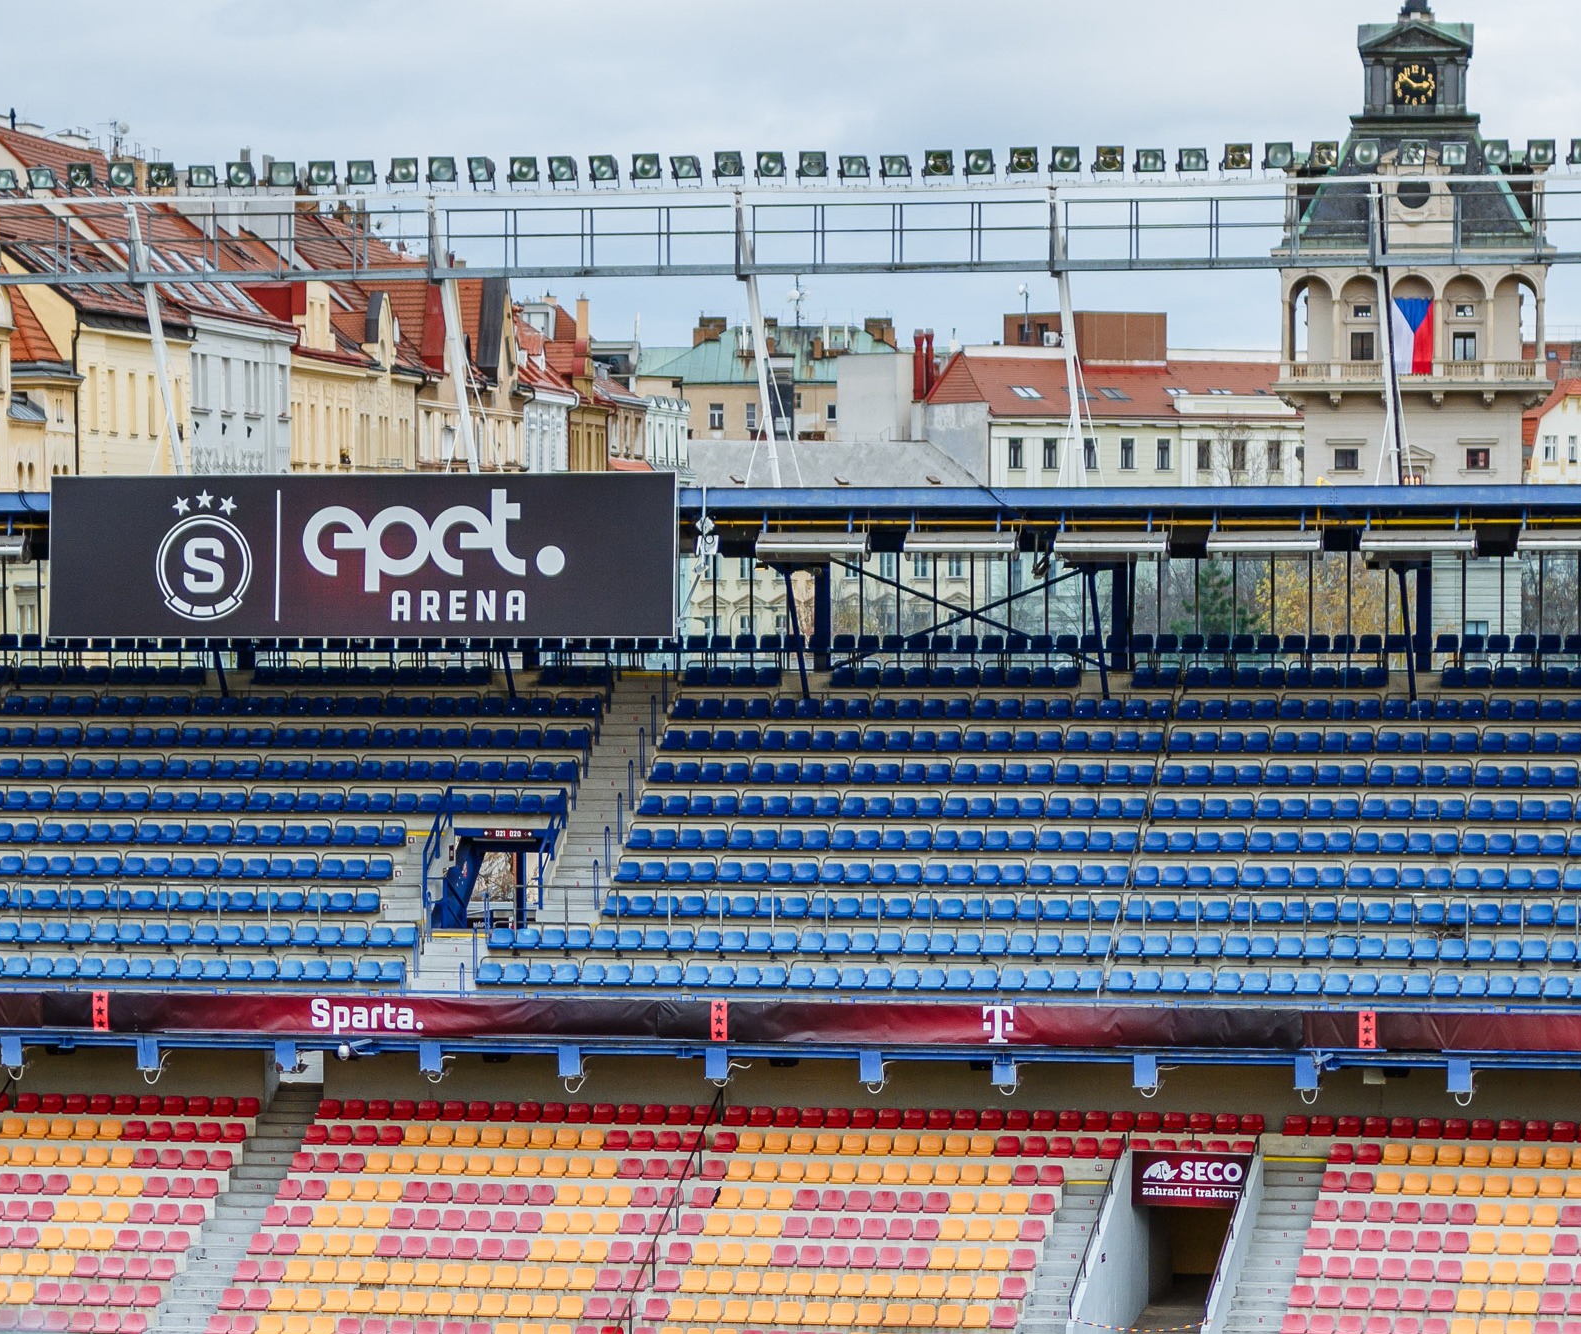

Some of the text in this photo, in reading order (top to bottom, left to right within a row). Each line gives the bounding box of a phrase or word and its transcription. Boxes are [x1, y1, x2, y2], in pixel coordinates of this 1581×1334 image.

[183, 537, 225, 593] S
[391, 590, 526, 622] ARENA
[311, 998, 424, 1034] Sparta.
[1180, 1161, 1242, 1182] SECO
[1142, 1186, 1240, 1200] zahradní traktory
